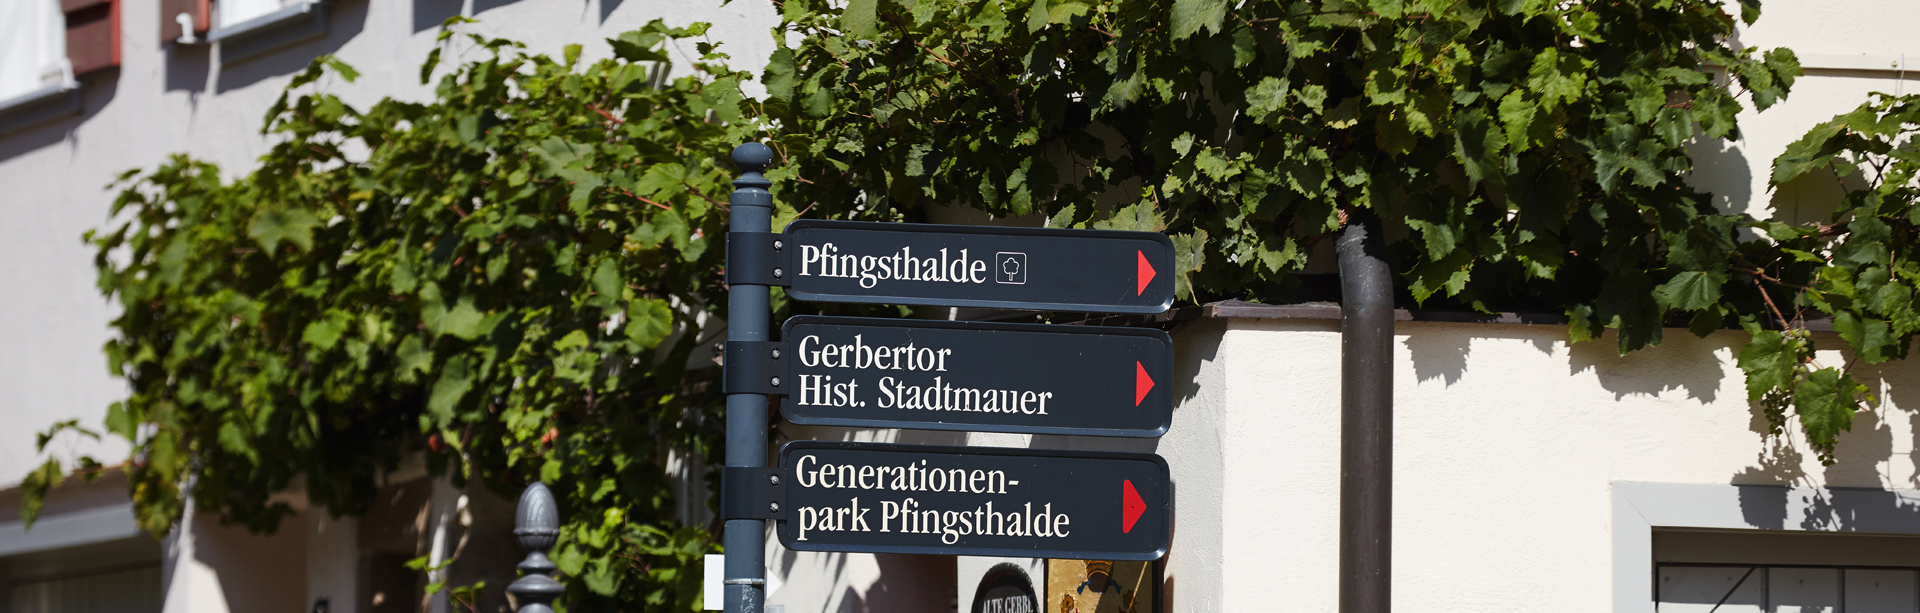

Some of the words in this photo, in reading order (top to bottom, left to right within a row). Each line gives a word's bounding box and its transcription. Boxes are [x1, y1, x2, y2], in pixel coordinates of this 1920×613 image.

[798, 242, 986, 288] Pfingsthalde
[798, 334, 952, 371] Gerbertor
[797, 374, 866, 407] Hist.
[877, 376, 1053, 415] Stadtmauer
[795, 454, 1020, 494] Generationen-
[797, 497, 872, 541] park
[880, 498, 1070, 545] Pfingsthalde
